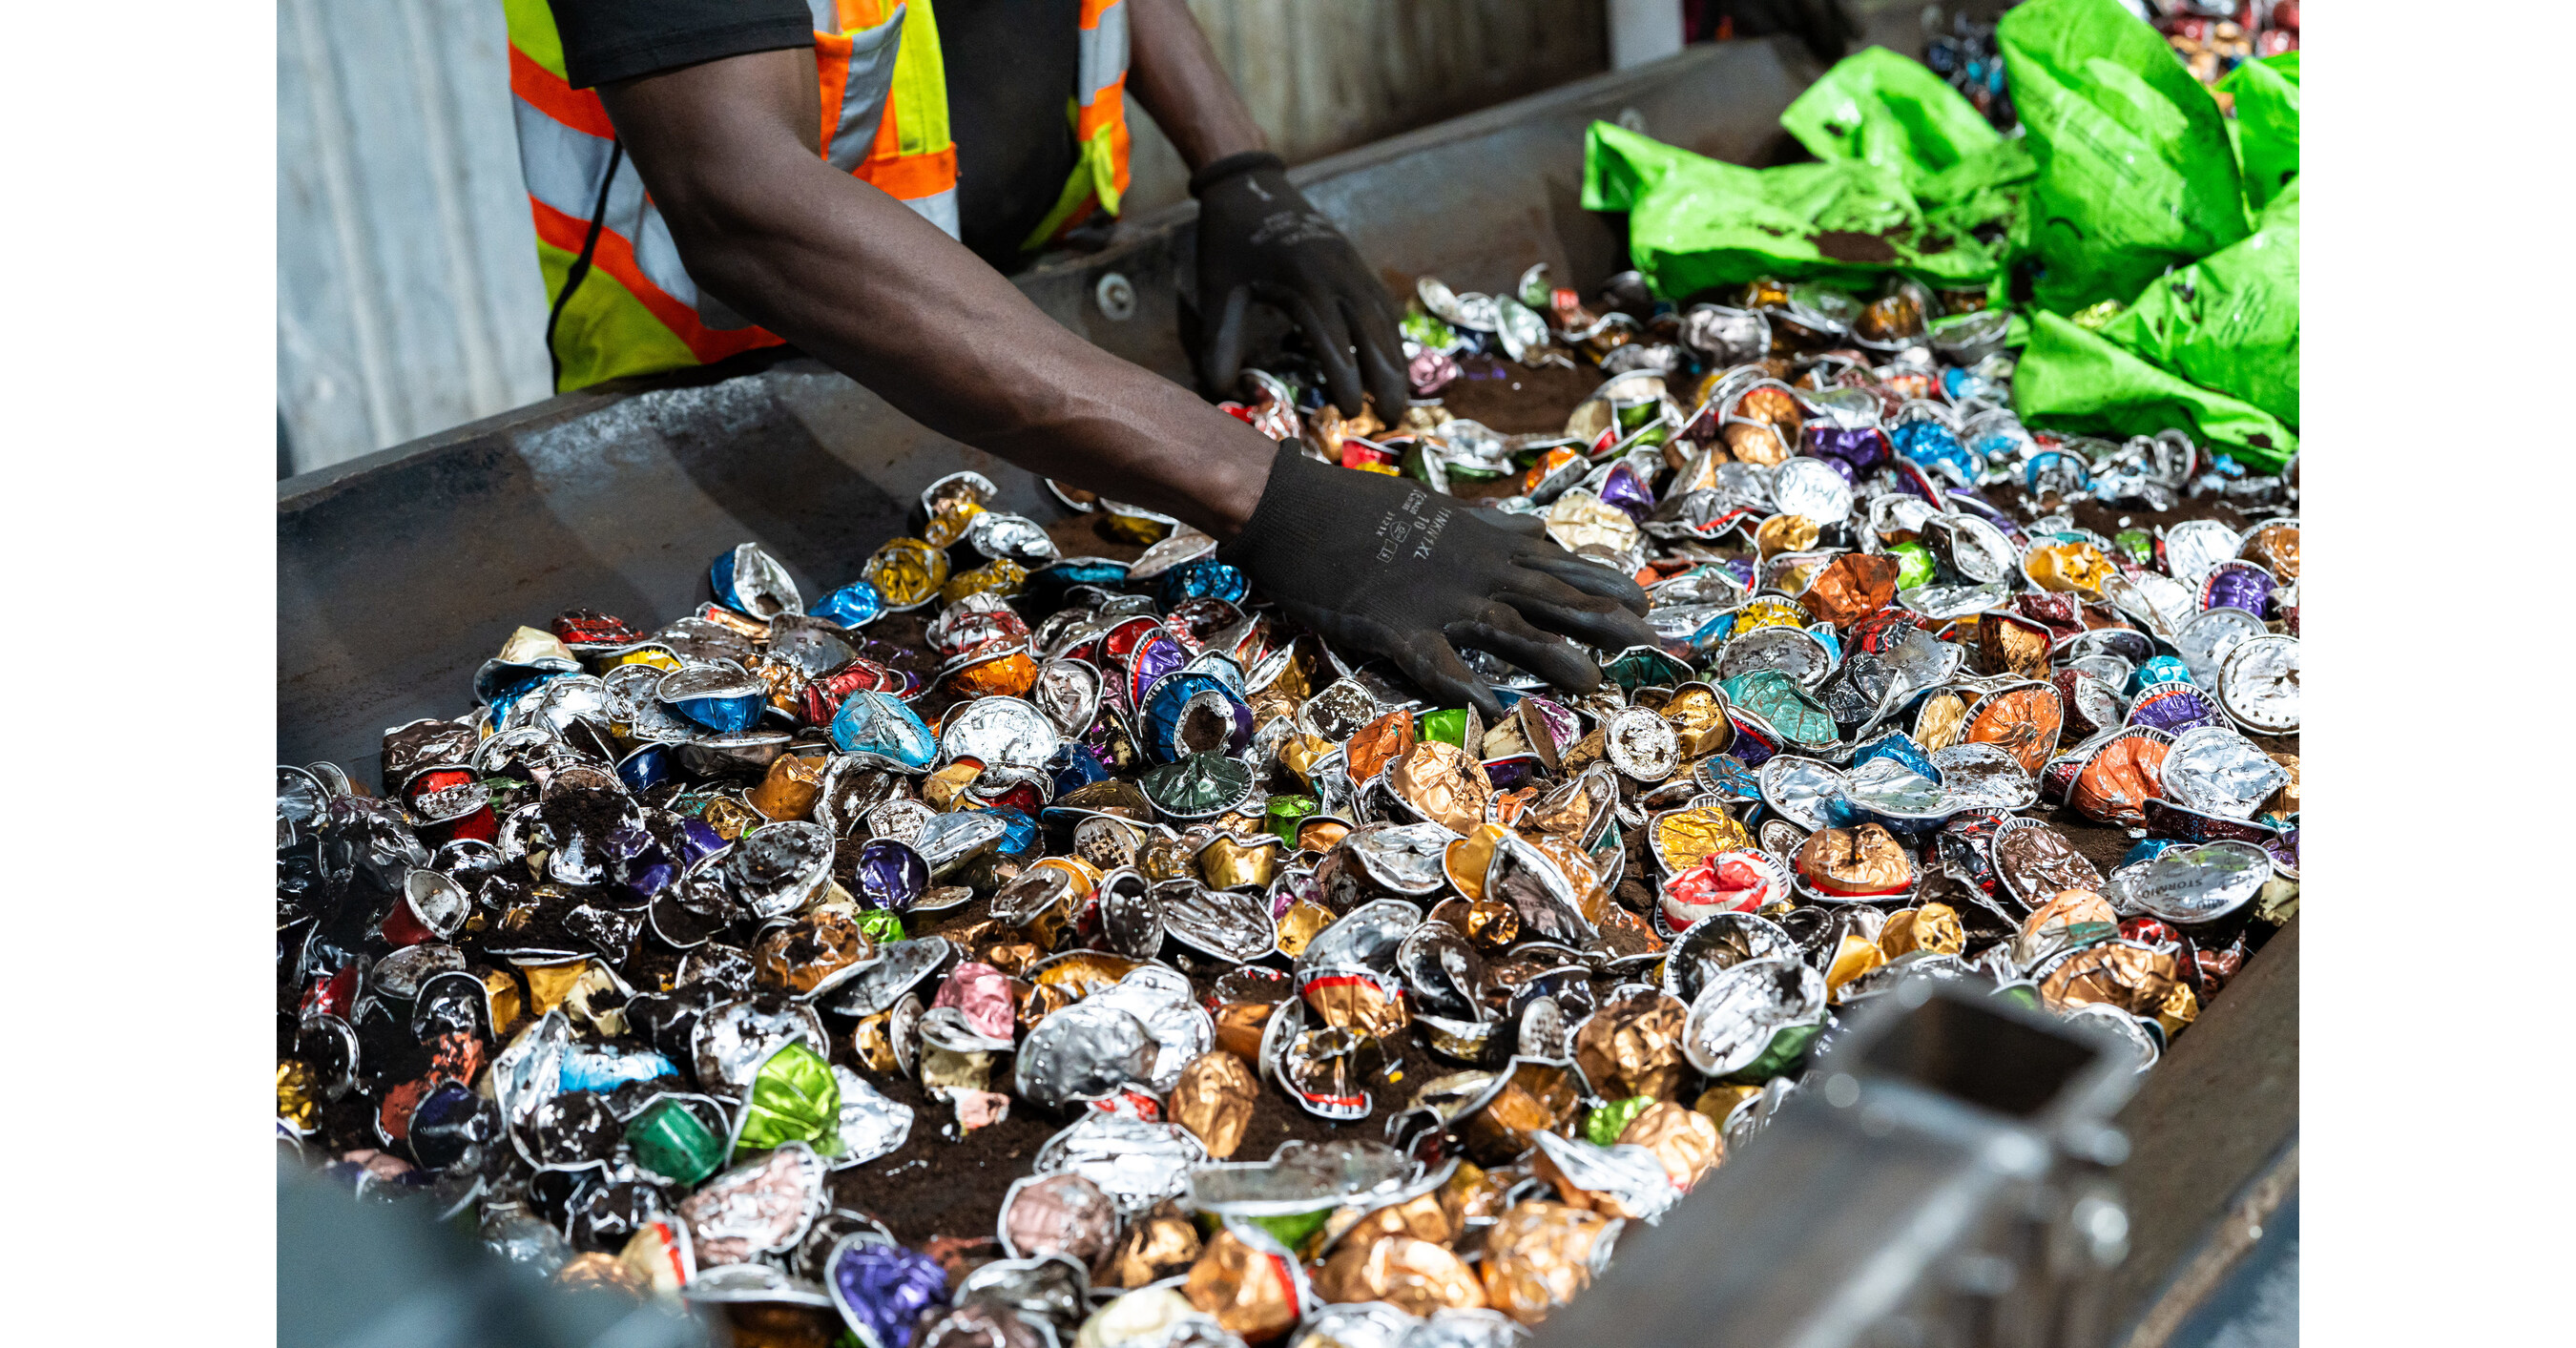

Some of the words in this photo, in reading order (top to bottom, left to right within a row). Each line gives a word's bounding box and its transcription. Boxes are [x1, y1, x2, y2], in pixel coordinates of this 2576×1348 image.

[1376, 511, 1395, 536] 3121X
[1414, 516, 1430, 529] 10
[2142, 880, 2203, 898] STORMIO
